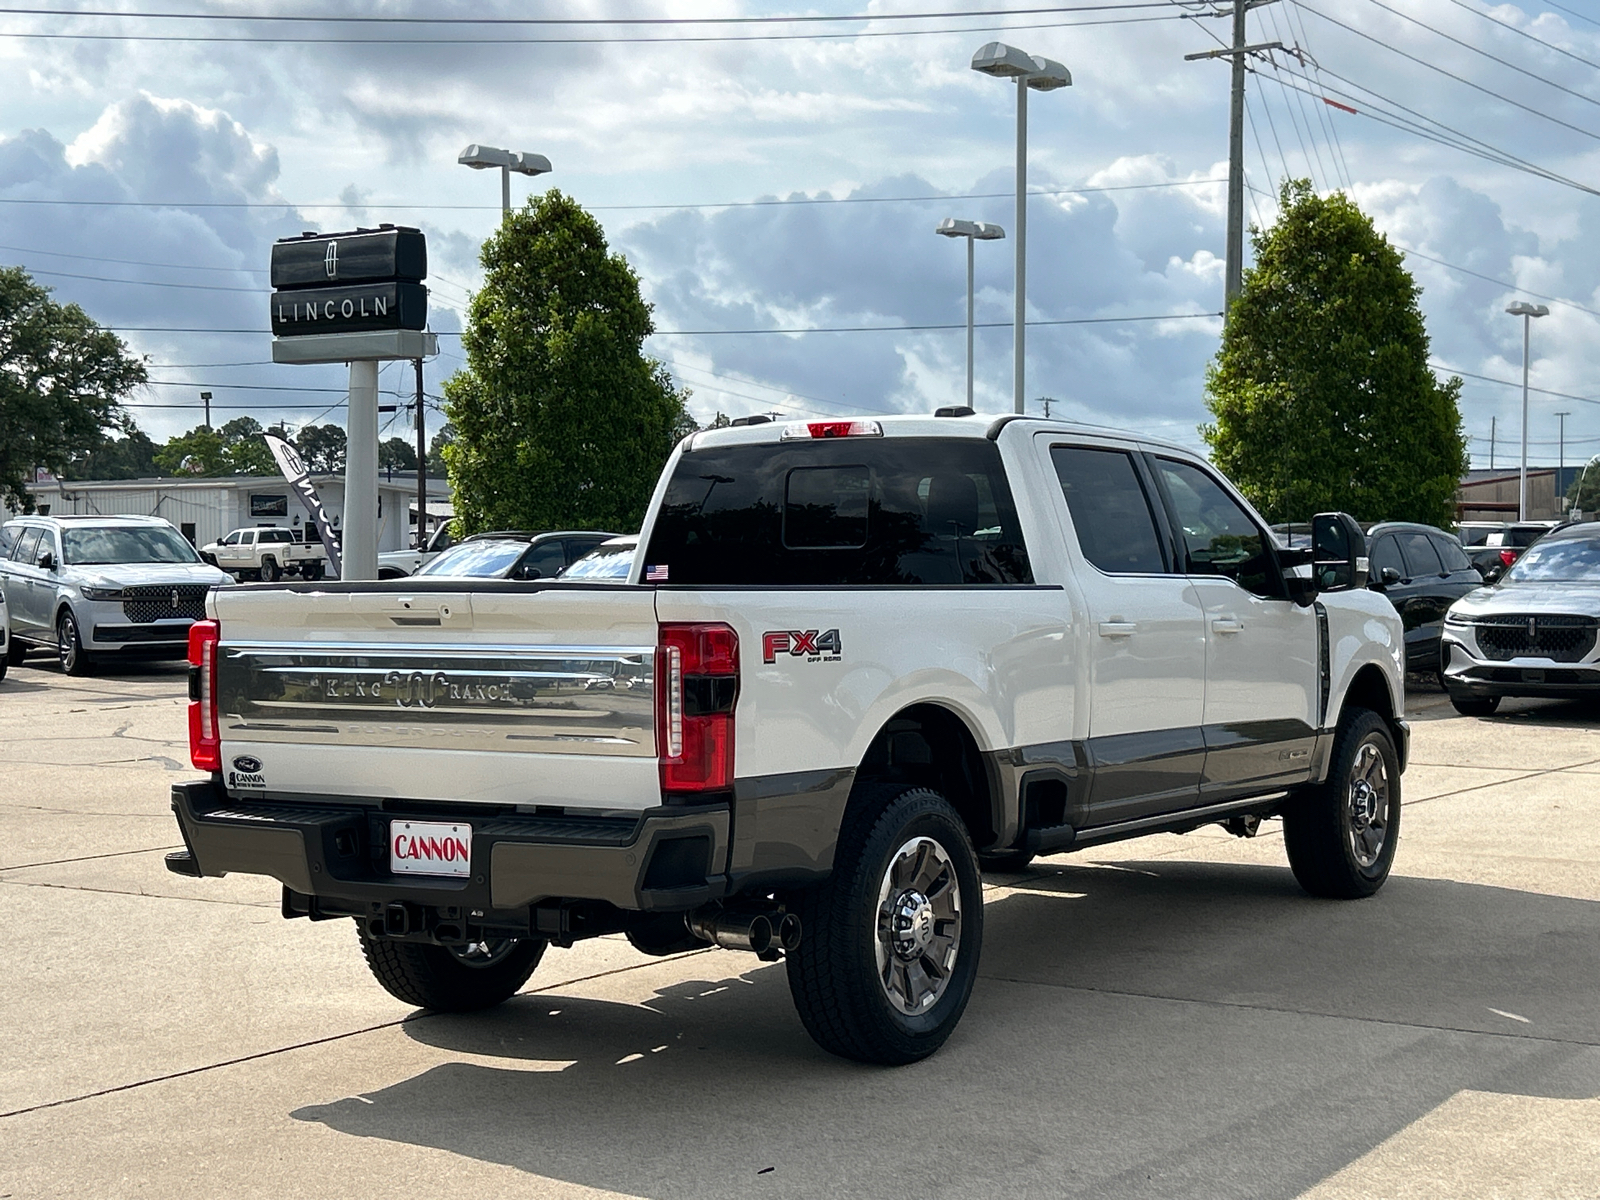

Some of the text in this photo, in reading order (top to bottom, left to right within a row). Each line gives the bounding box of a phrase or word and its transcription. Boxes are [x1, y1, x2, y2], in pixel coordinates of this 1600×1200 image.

[279, 296, 387, 323] LINCOLN
[762, 629, 842, 665] FX4
[326, 679, 512, 702] KING RANCH
[236, 773, 266, 783] CANNON
[394, 834, 468, 862] CANNON
